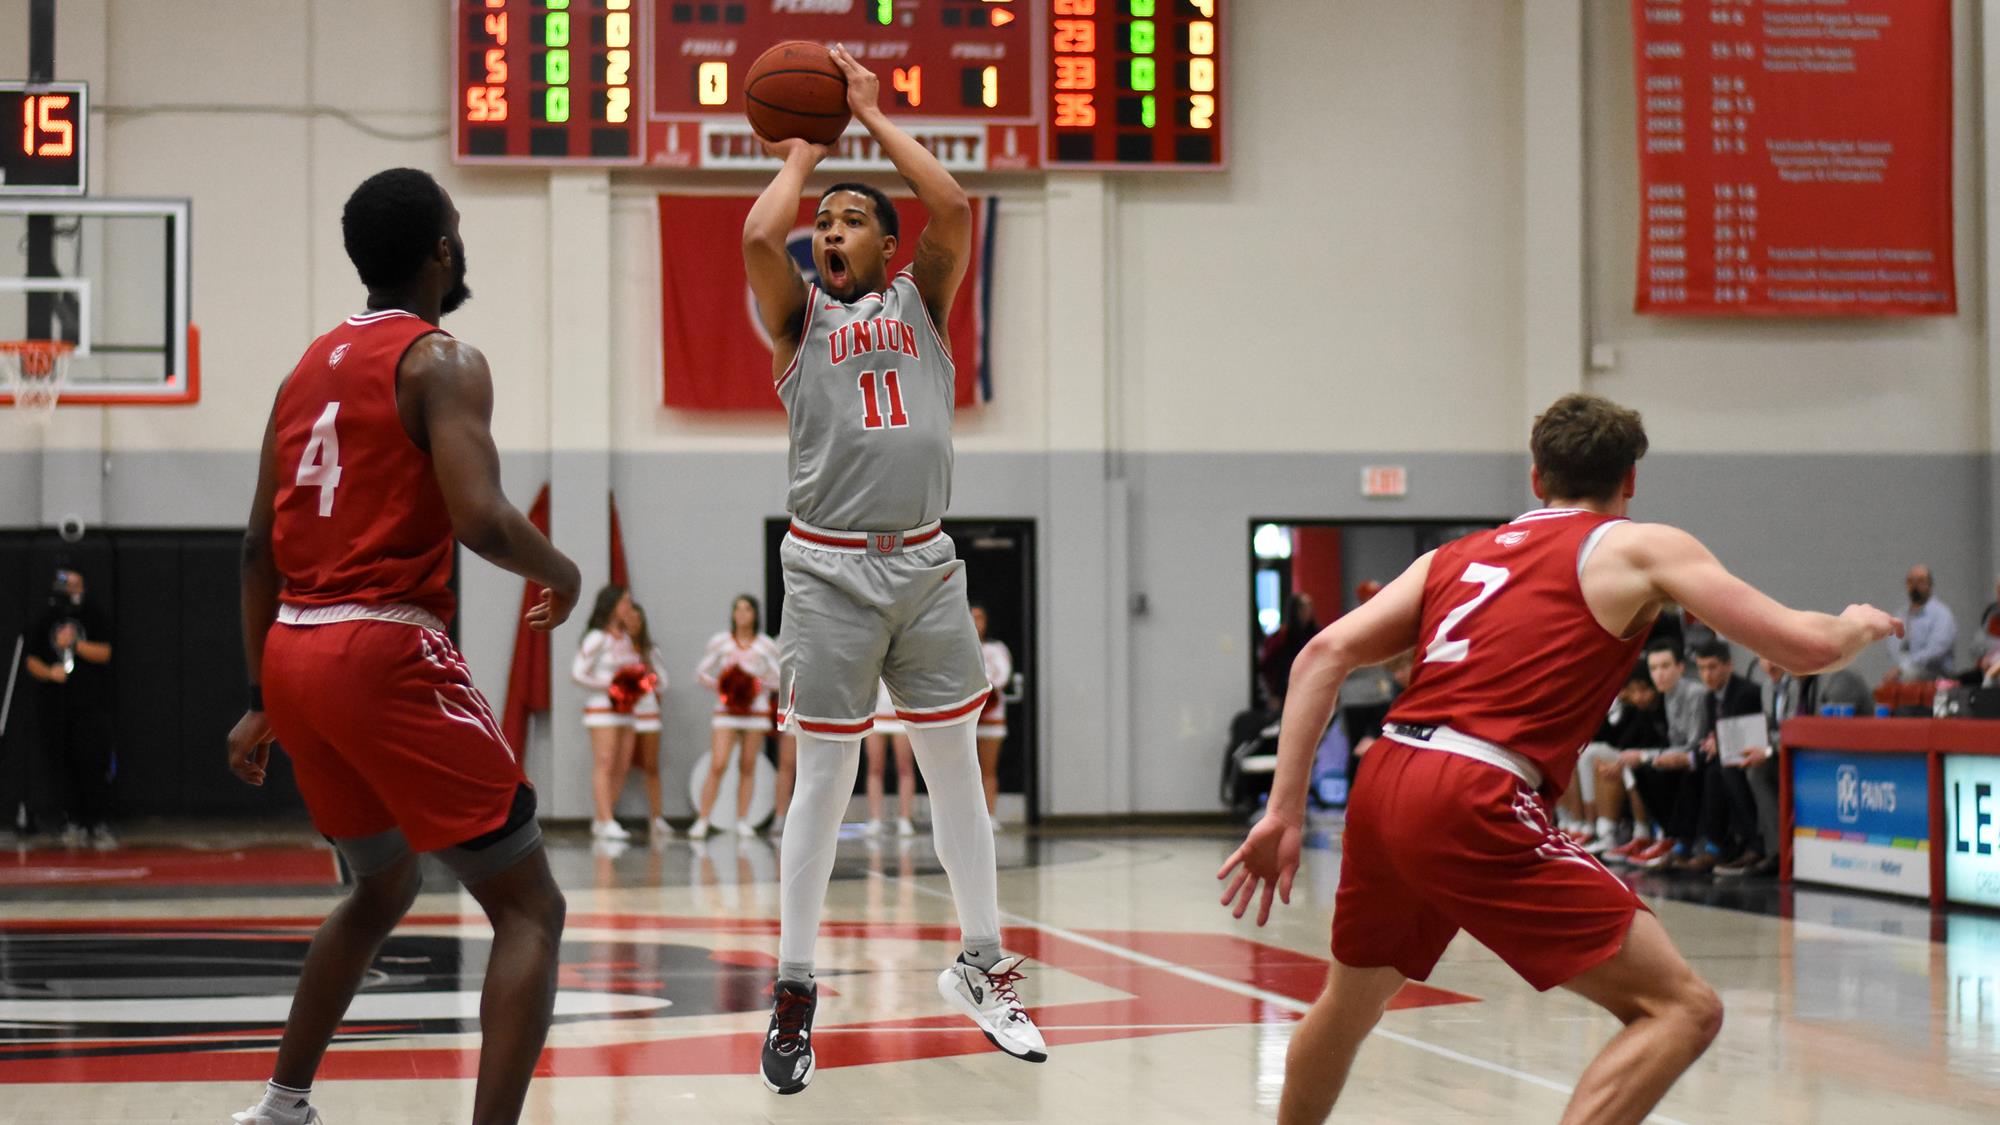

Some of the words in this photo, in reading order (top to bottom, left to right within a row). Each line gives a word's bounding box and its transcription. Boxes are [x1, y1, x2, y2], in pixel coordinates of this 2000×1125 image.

[485, 12, 507, 45] 4
[546, 12, 569, 47] 0
[606, 12, 630, 47] 0
[1130, 20, 1154, 53] 0
[1189, 21, 1214, 55] 0
[485, 49, 507, 83] 5
[546, 49, 569, 84] 0
[606, 49, 630, 85] 2
[699, 62, 727, 105] 0
[893, 65, 921, 107] 4
[982, 66, 997, 108] 1
[1054, 57, 1096, 89] 33
[1131, 57, 1155, 91] 0
[1189, 58, 1214, 92] 0
[467, 86, 507, 121] 55
[546, 87, 569, 122] 0
[606, 87, 630, 122] 2
[1054, 93, 1096, 127] 35
[1142, 96, 1155, 128] 1
[1189, 95, 1214, 129] 2
[24, 95, 73, 156] 15
[828, 317, 920, 366] UNION
[858, 368, 909, 431] 11
[296, 401, 343, 517] 4
[875, 535, 897, 554] U
[1423, 562, 1511, 663] 2
[1860, 780, 1897, 813] PAINTS
[1955, 780, 2000, 855] LE
